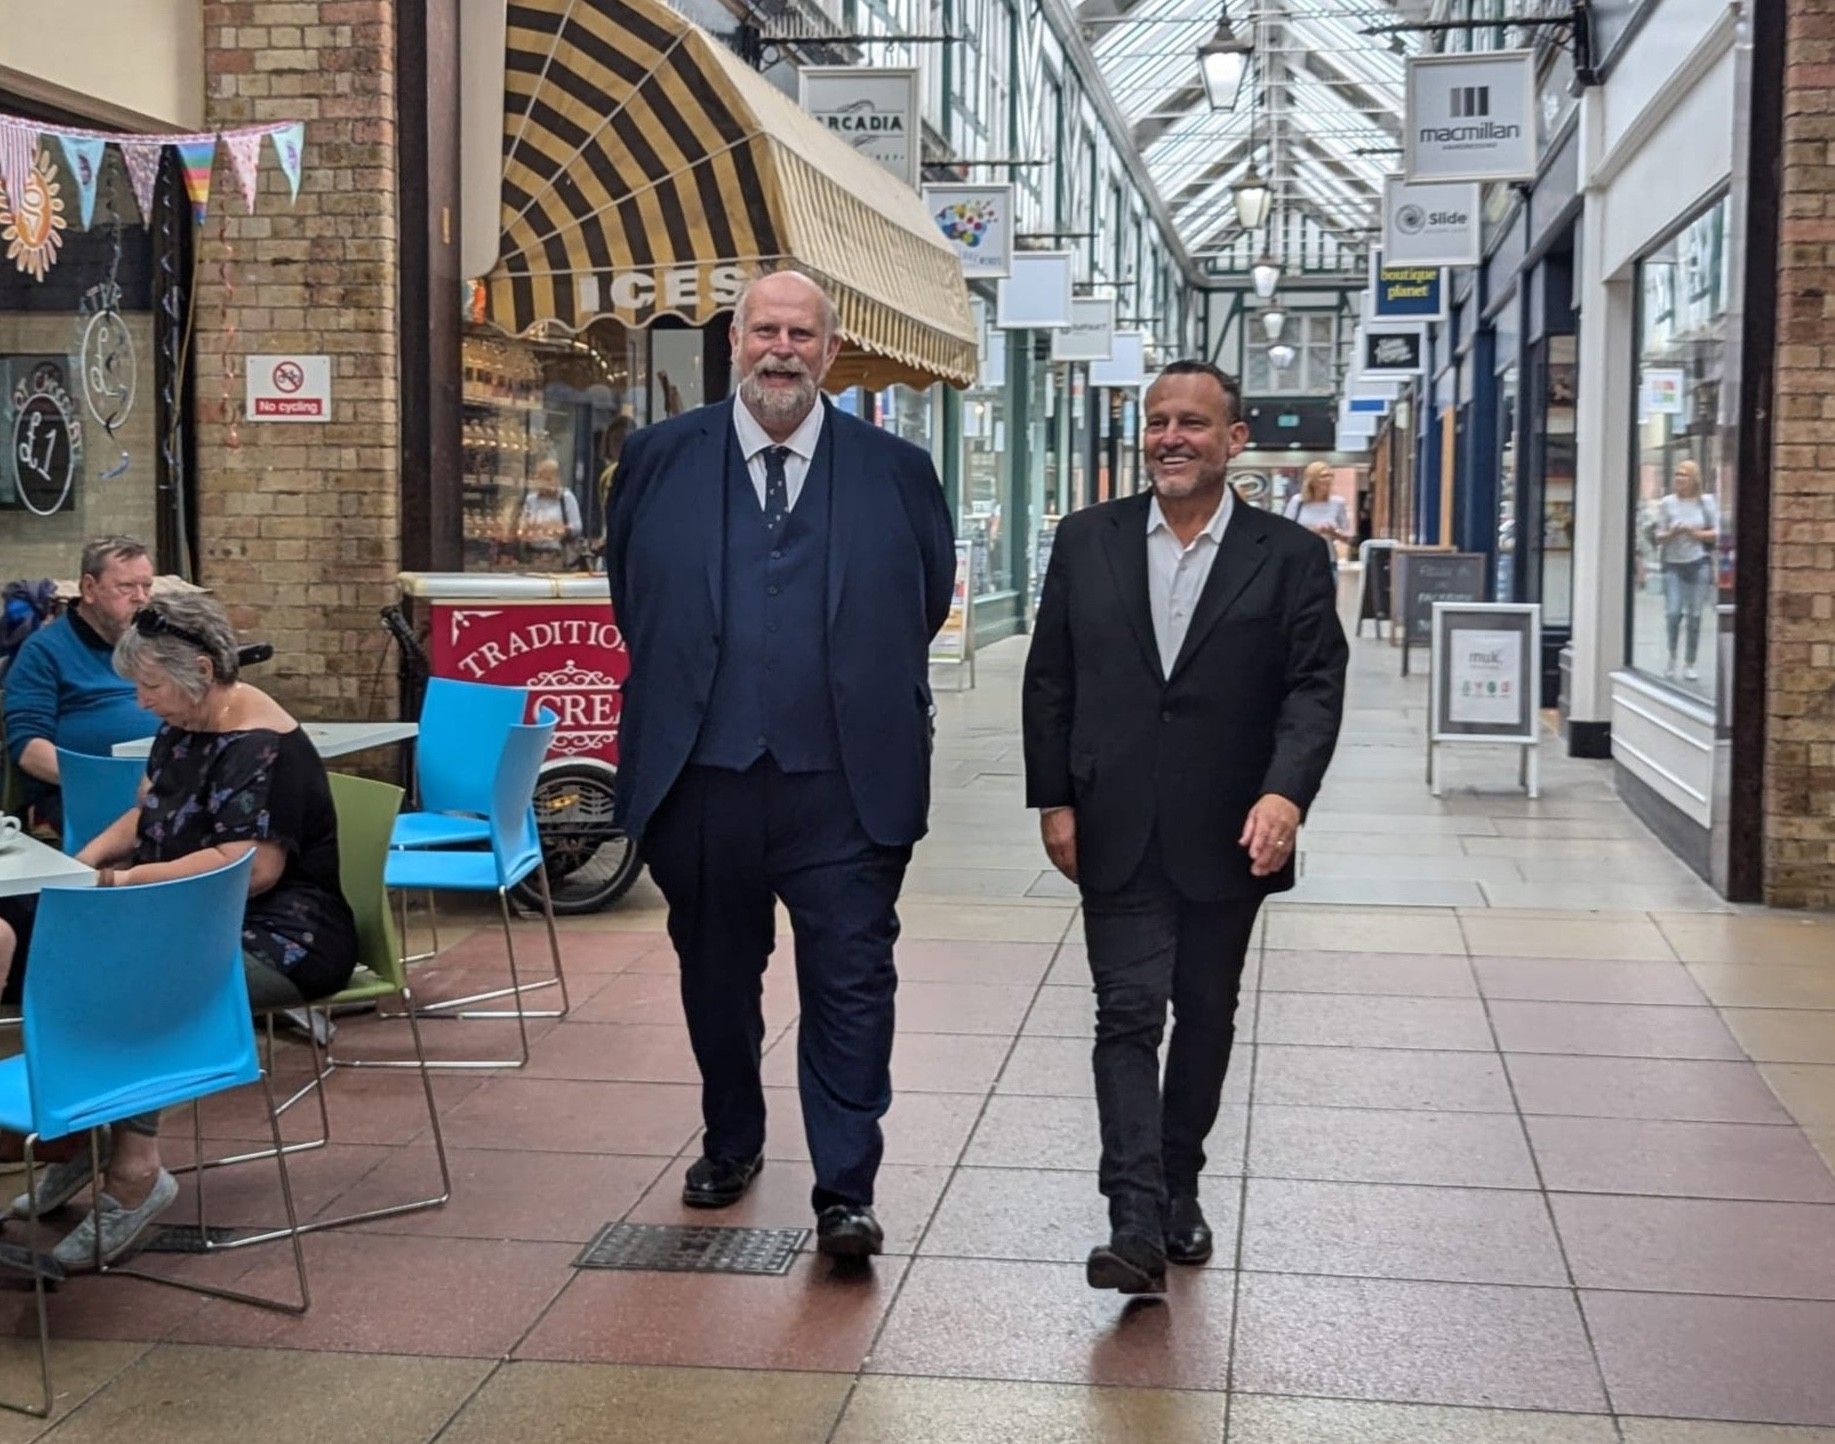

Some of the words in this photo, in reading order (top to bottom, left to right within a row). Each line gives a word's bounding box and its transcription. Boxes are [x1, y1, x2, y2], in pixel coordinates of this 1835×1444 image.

[1420, 122, 1520, 142] macmillan
[1429, 212, 1468, 226] Slide
[580, 266, 748, 312] ICES
[1388, 285, 1429, 300] planet
[258, 400, 276, 412] No
[278, 400, 318, 414] cycling
[458, 620, 626, 679] TRADITIO
[534, 694, 621, 726] CRE
